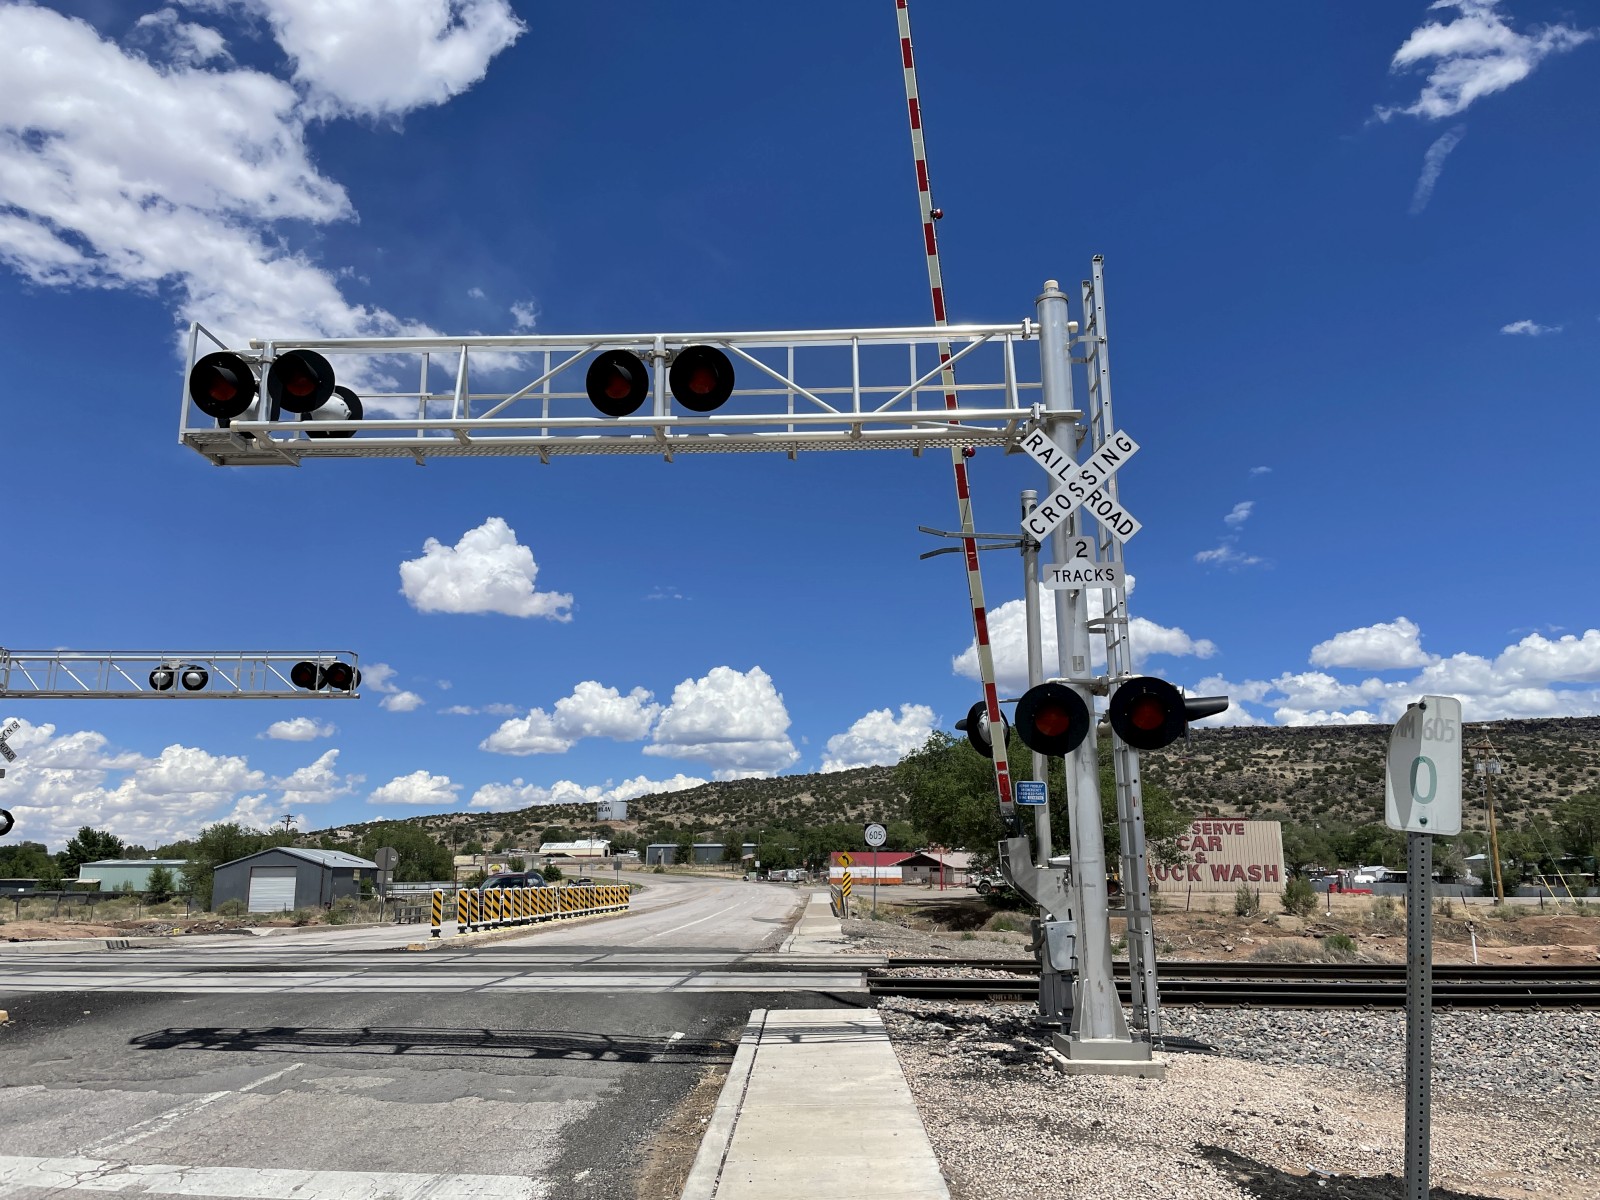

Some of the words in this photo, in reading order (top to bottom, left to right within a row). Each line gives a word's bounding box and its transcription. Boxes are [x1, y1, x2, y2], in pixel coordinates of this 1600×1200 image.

[1029, 437, 1133, 534] CROSSING
[1085, 489, 1134, 536] ROAD
[1075, 541, 1088, 558] 2
[1053, 568, 1115, 583] TRACKS
[1423, 717, 1456, 743] 605
[869, 831, 882, 839] 605
[1192, 823, 1245, 835] SERVE
[1176, 836, 1223, 851] CAR
[1195, 852, 1207, 863] &
[1155, 864, 1202, 881] UCK
[1210, 864, 1279, 882] WASH
